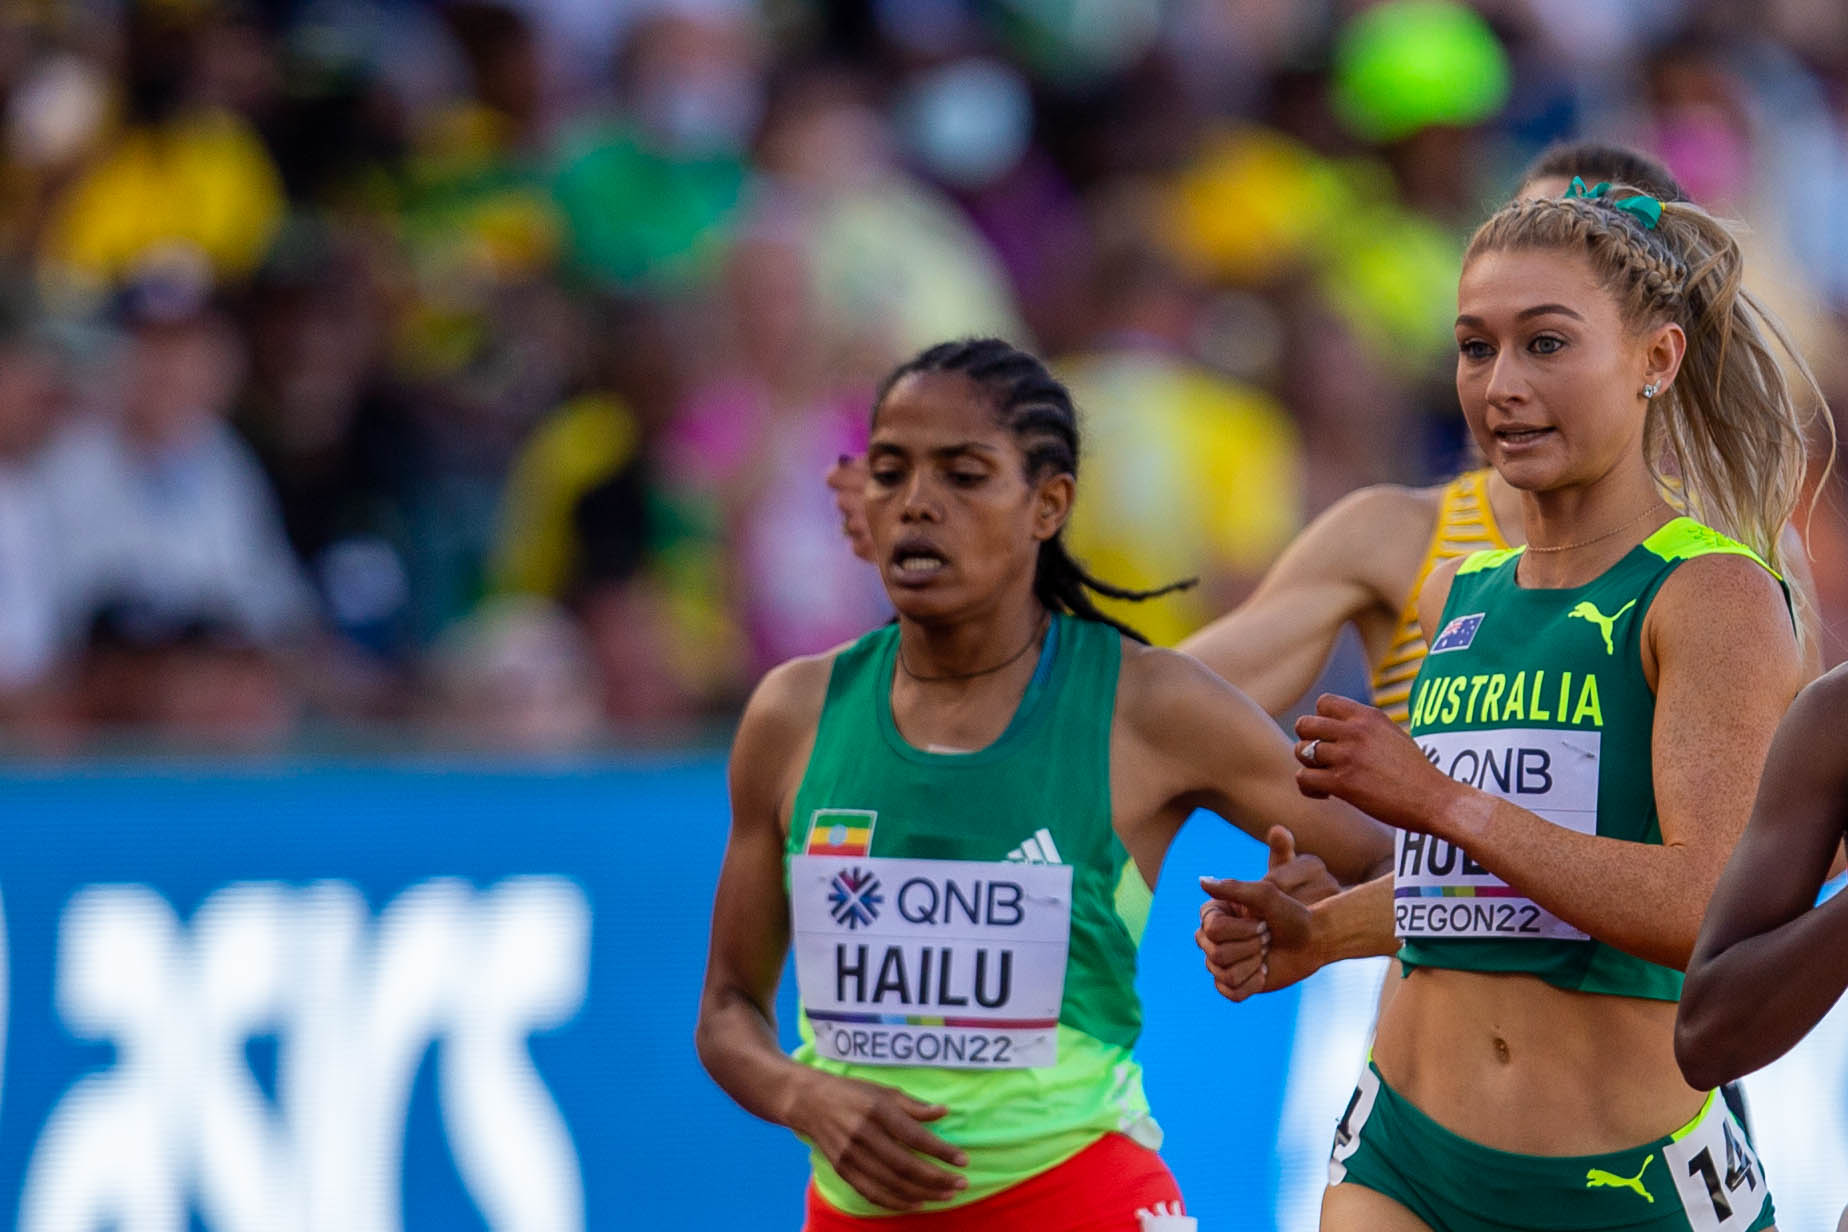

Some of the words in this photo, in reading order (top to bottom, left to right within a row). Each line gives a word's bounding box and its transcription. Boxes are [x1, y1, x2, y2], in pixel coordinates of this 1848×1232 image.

[1411, 670, 1603, 728] AUSTRALIA
[1450, 748, 1552, 795] QNB
[897, 876, 1026, 926] QNB
[1396, 904, 1541, 933] REGON22
[835, 944, 1014, 1008] HAILU
[834, 1031, 1012, 1063] OREGON22
[1688, 1119, 1757, 1224] 14
